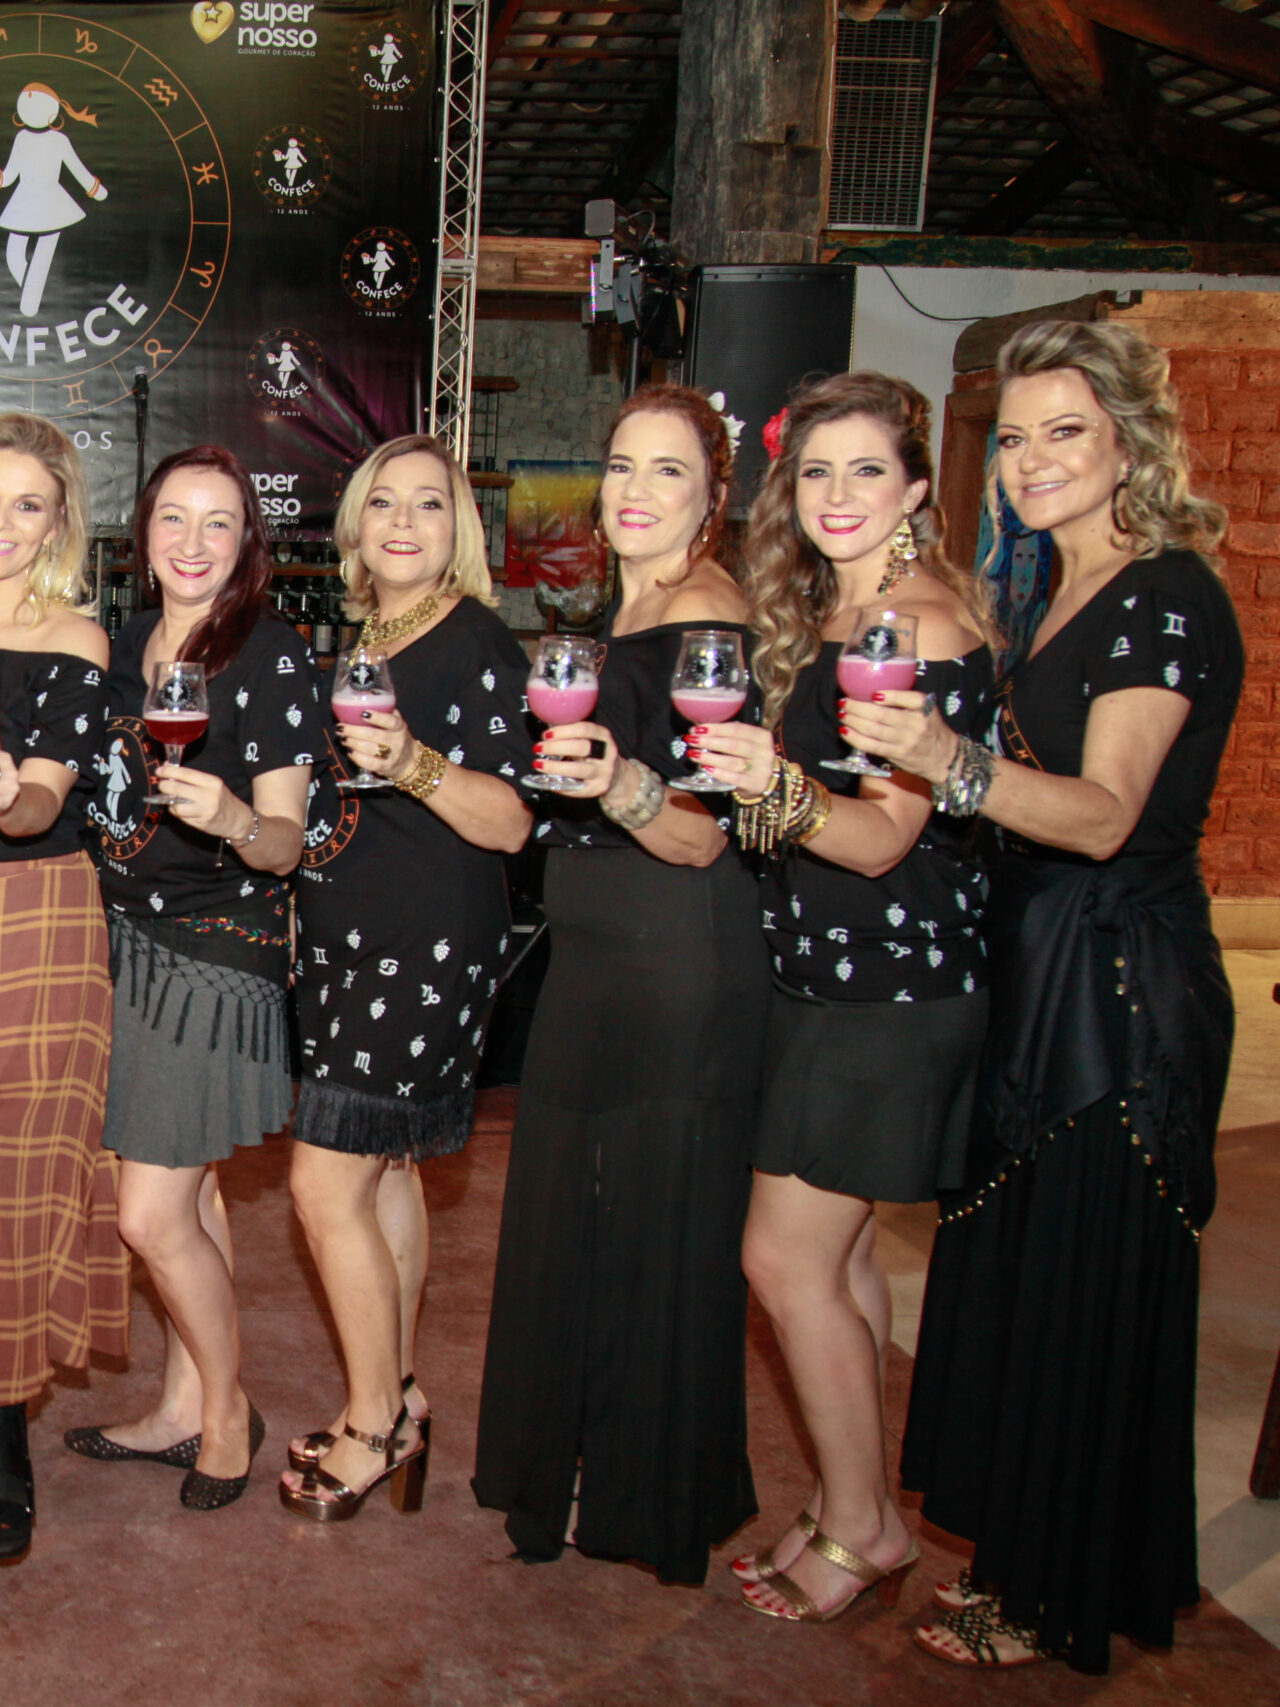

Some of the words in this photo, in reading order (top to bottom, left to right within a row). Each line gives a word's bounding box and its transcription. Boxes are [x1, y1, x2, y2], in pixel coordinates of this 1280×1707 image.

[239, 1, 315, 28] super
[238, 27, 318, 49] nosso
[282, 49, 316, 57] CORAÇÃO
[363, 72, 411, 93] CONFECE
[268, 177, 316, 197] CONFECE
[355, 280, 403, 300] CONFECE
[261, 380, 309, 399] CONFECE
[73, 430, 113, 450] OS
[250, 473, 299, 496] per
[259, 497, 301, 517] sso
